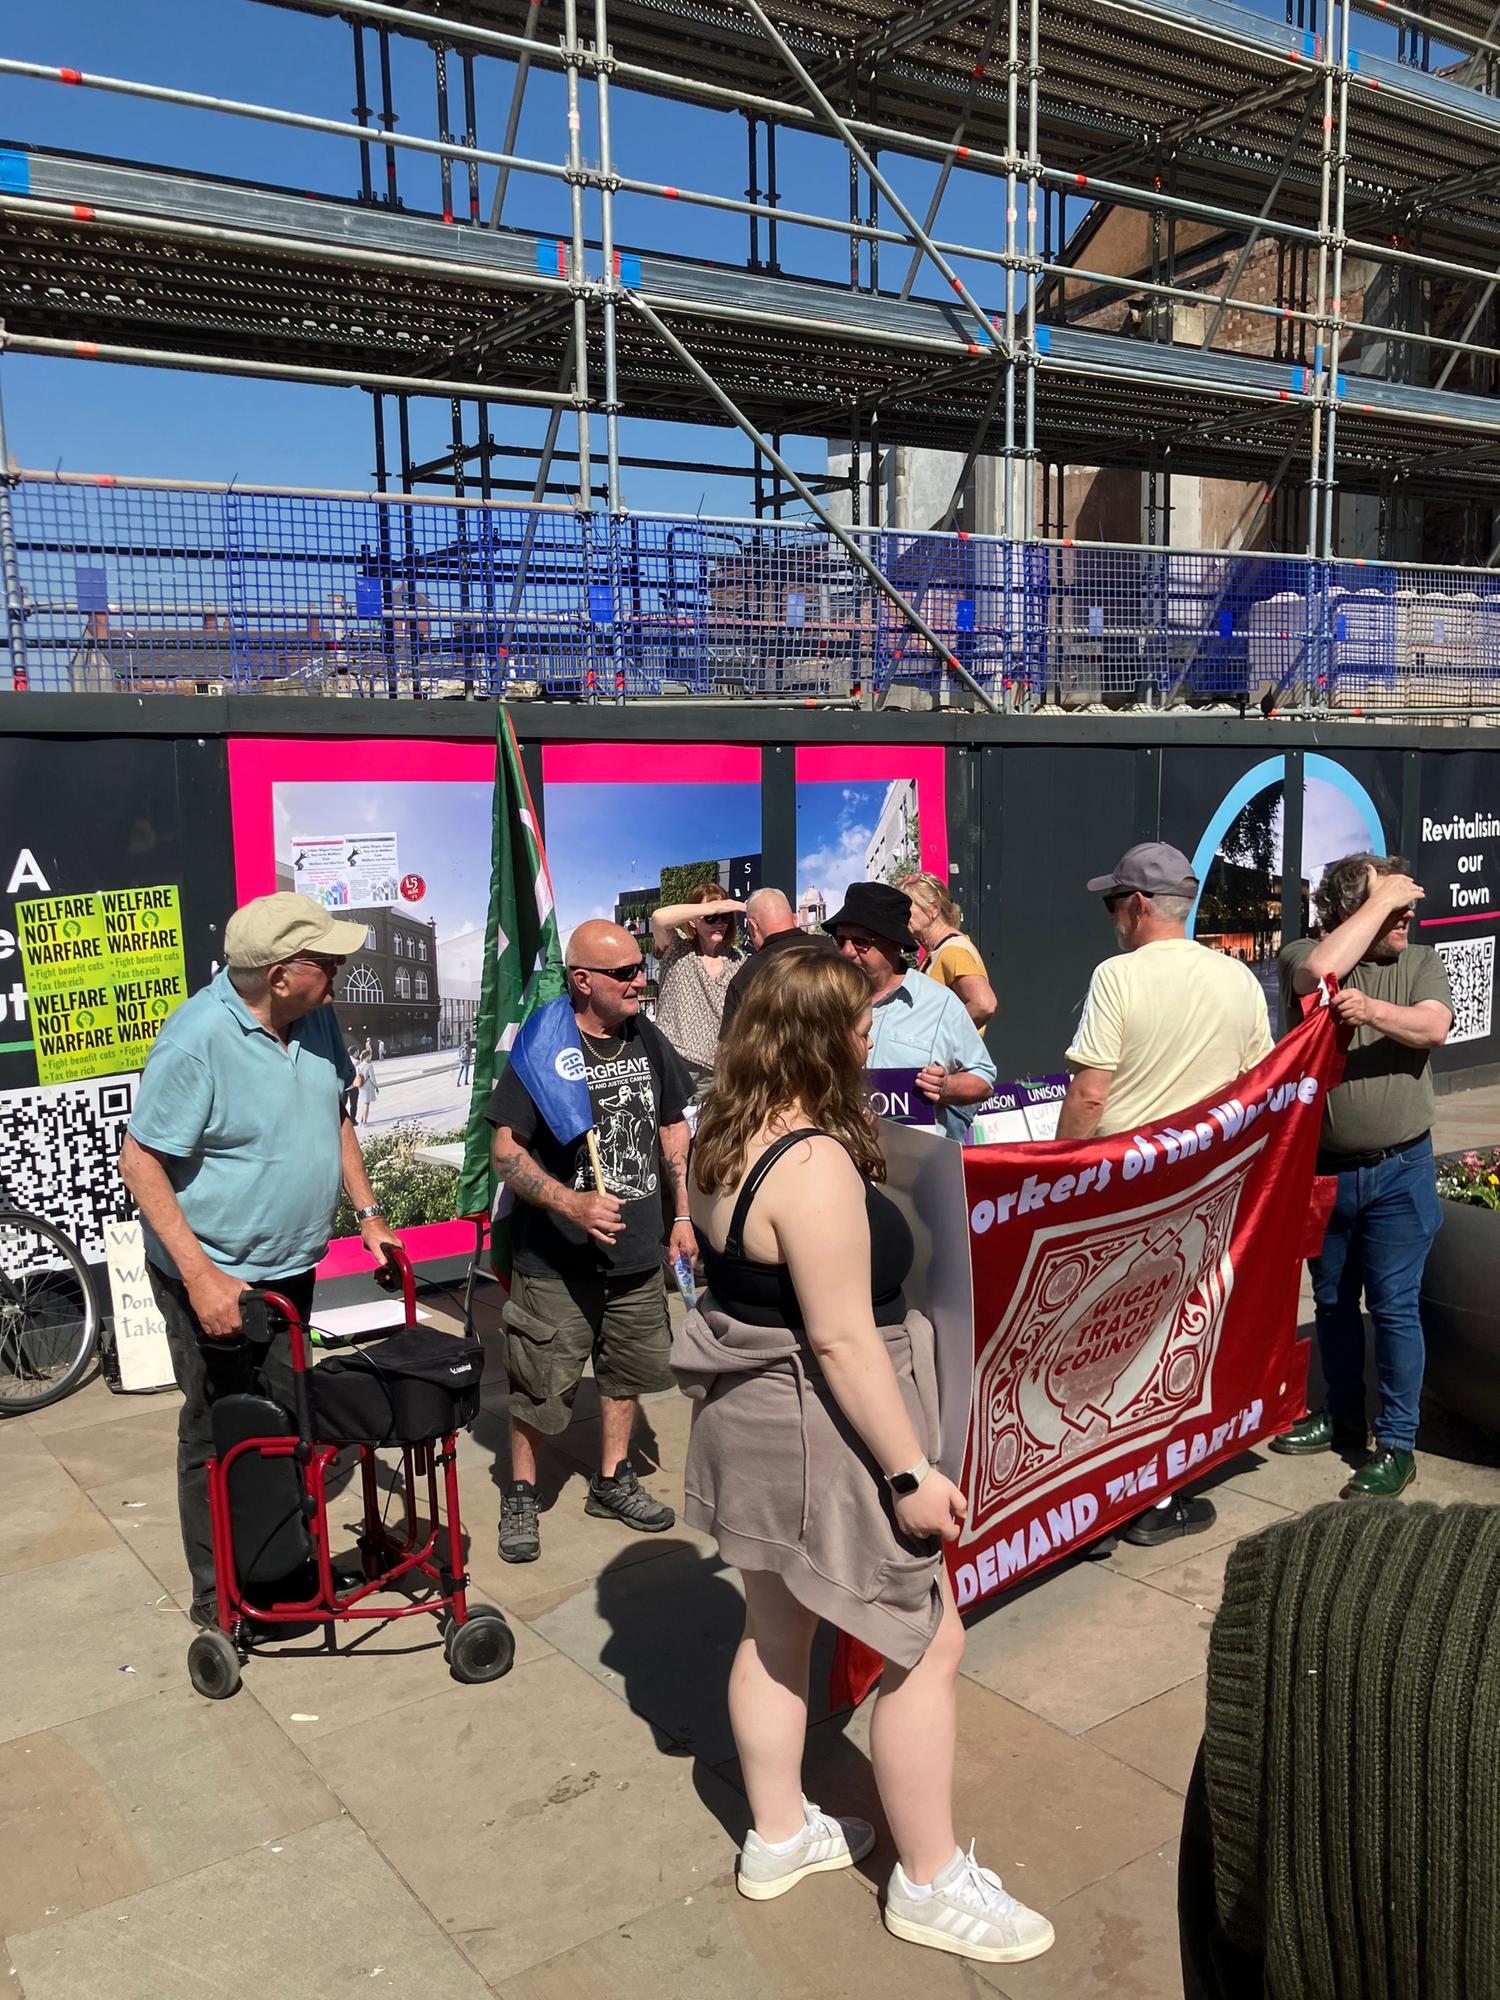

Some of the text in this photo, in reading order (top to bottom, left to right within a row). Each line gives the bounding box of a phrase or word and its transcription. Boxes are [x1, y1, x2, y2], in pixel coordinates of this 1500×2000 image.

[6, 848, 51, 893] A
[1457, 854, 1484, 873] our
[102, 889, 173, 913] WELFARE
[1450, 883, 1490, 907] Town
[21, 898, 95, 924] WELFARE
[105, 912, 136, 934] NOT
[25, 923, 57, 945] NOT
[107, 929, 179, 954] WARFARE
[27, 938, 103, 966] WARFARE
[115, 951, 180, 968] Fight benefit cuts
[36, 962, 104, 979] Fight benefit cuts
[116, 965, 160, 979] Tax the rich
[37, 977, 85, 991] Tax the rich
[113, 976, 181, 1003] WELFARE
[34, 987, 108, 1015] WELFARE
[116, 1001, 147, 1023] NOT
[38, 1013, 71, 1036] NOT
[117, 1018, 165, 1043] WARF
[40, 1027, 114, 1056] WARFARE
[124, 1045, 143, 1056] Fight
[48, 1050, 116, 1070] Fight benefit cuts
[126, 1058, 139, 1068] Tax
[584, 1056, 650, 1081] RGREAVE
[49, 1066, 96, 1081] Tax the rich
[608, 1078, 629, 1088] JUSTICE
[629, 1074, 652, 1083] CAMPAIG
[1027, 1084, 1067, 1102] UNISON
[970, 1158, 1113, 1234] orkers
[1152, 1122, 1214, 1165] the
[1093, 1270, 1176, 1320] WIGAN
[1076, 1295, 1164, 1348] TRADES
[1055, 1319, 1154, 1376] COUNCIL
[955, 1493, 1099, 1606] DEMAND
[1105, 1452, 1159, 1505] THE
